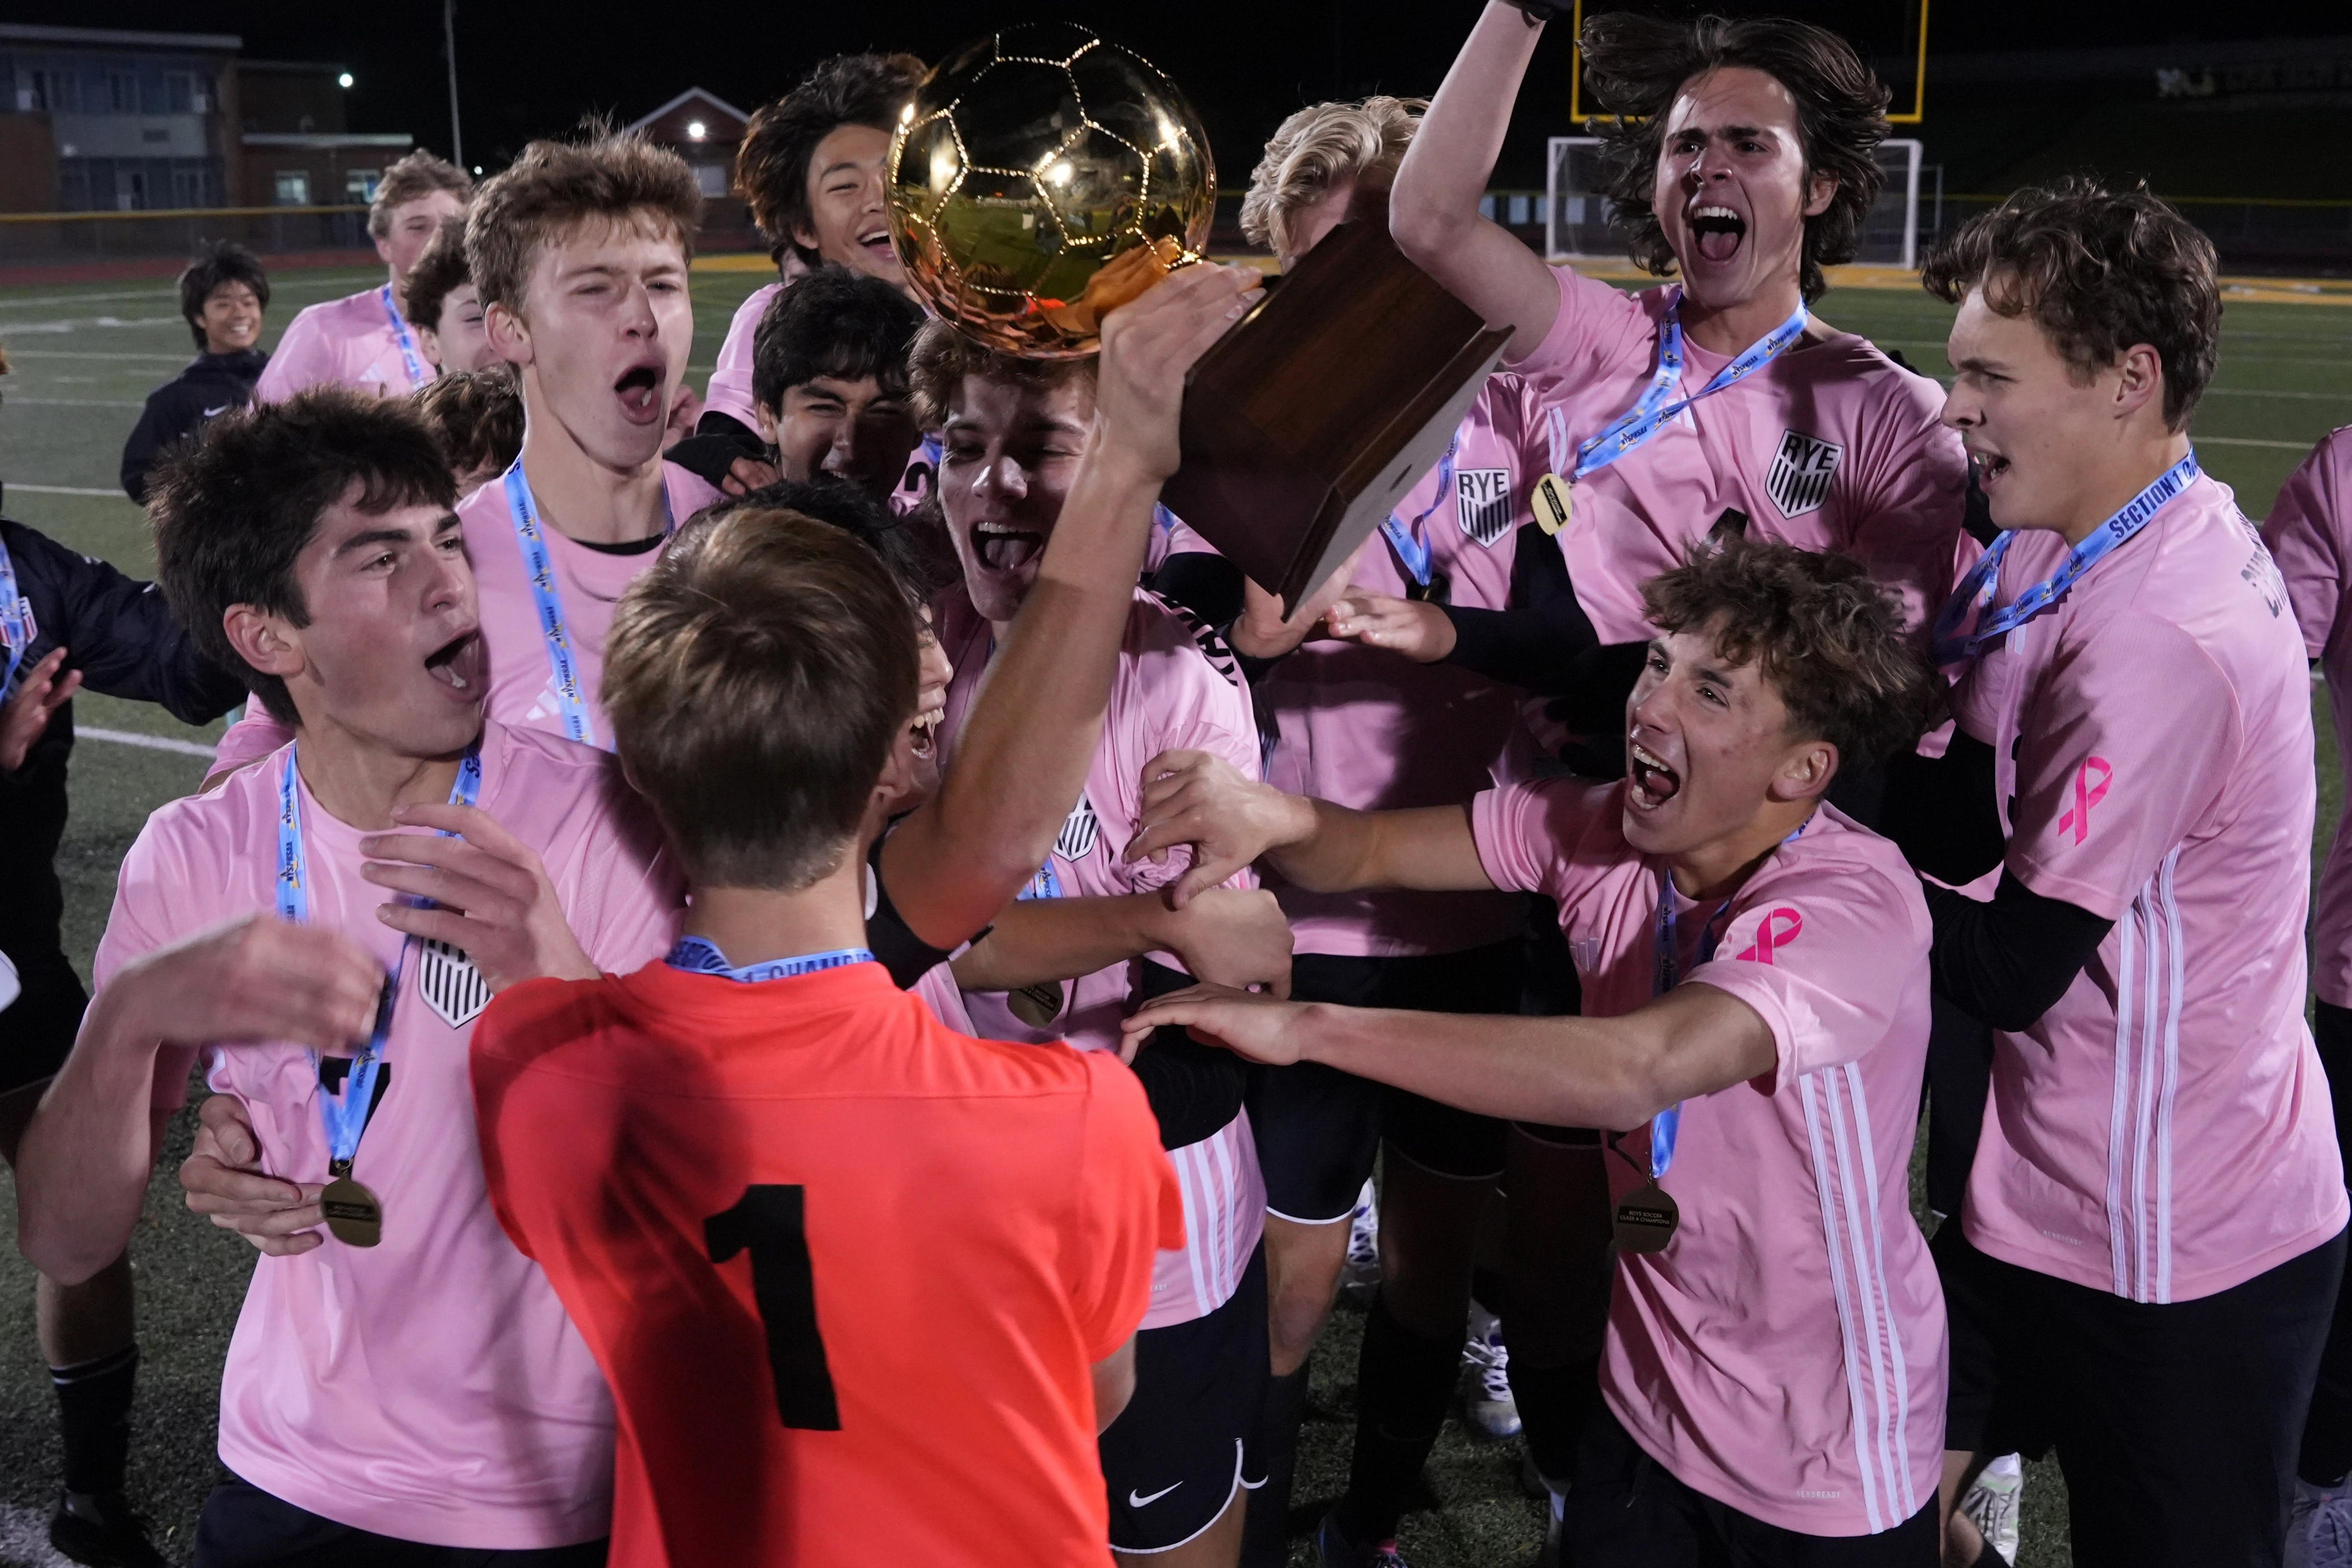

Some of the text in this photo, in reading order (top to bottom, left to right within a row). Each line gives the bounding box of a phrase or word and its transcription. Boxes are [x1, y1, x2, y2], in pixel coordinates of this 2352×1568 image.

[1782, 434, 1839, 471] RYE
[1458, 473, 1508, 502] RYE
[2109, 470, 2184, 539] SECTION 1
[560, 660, 575, 698] NYSPHSAA
[280, 842, 294, 882] NYSPHSAA
[704, 1184, 843, 1431] 1
